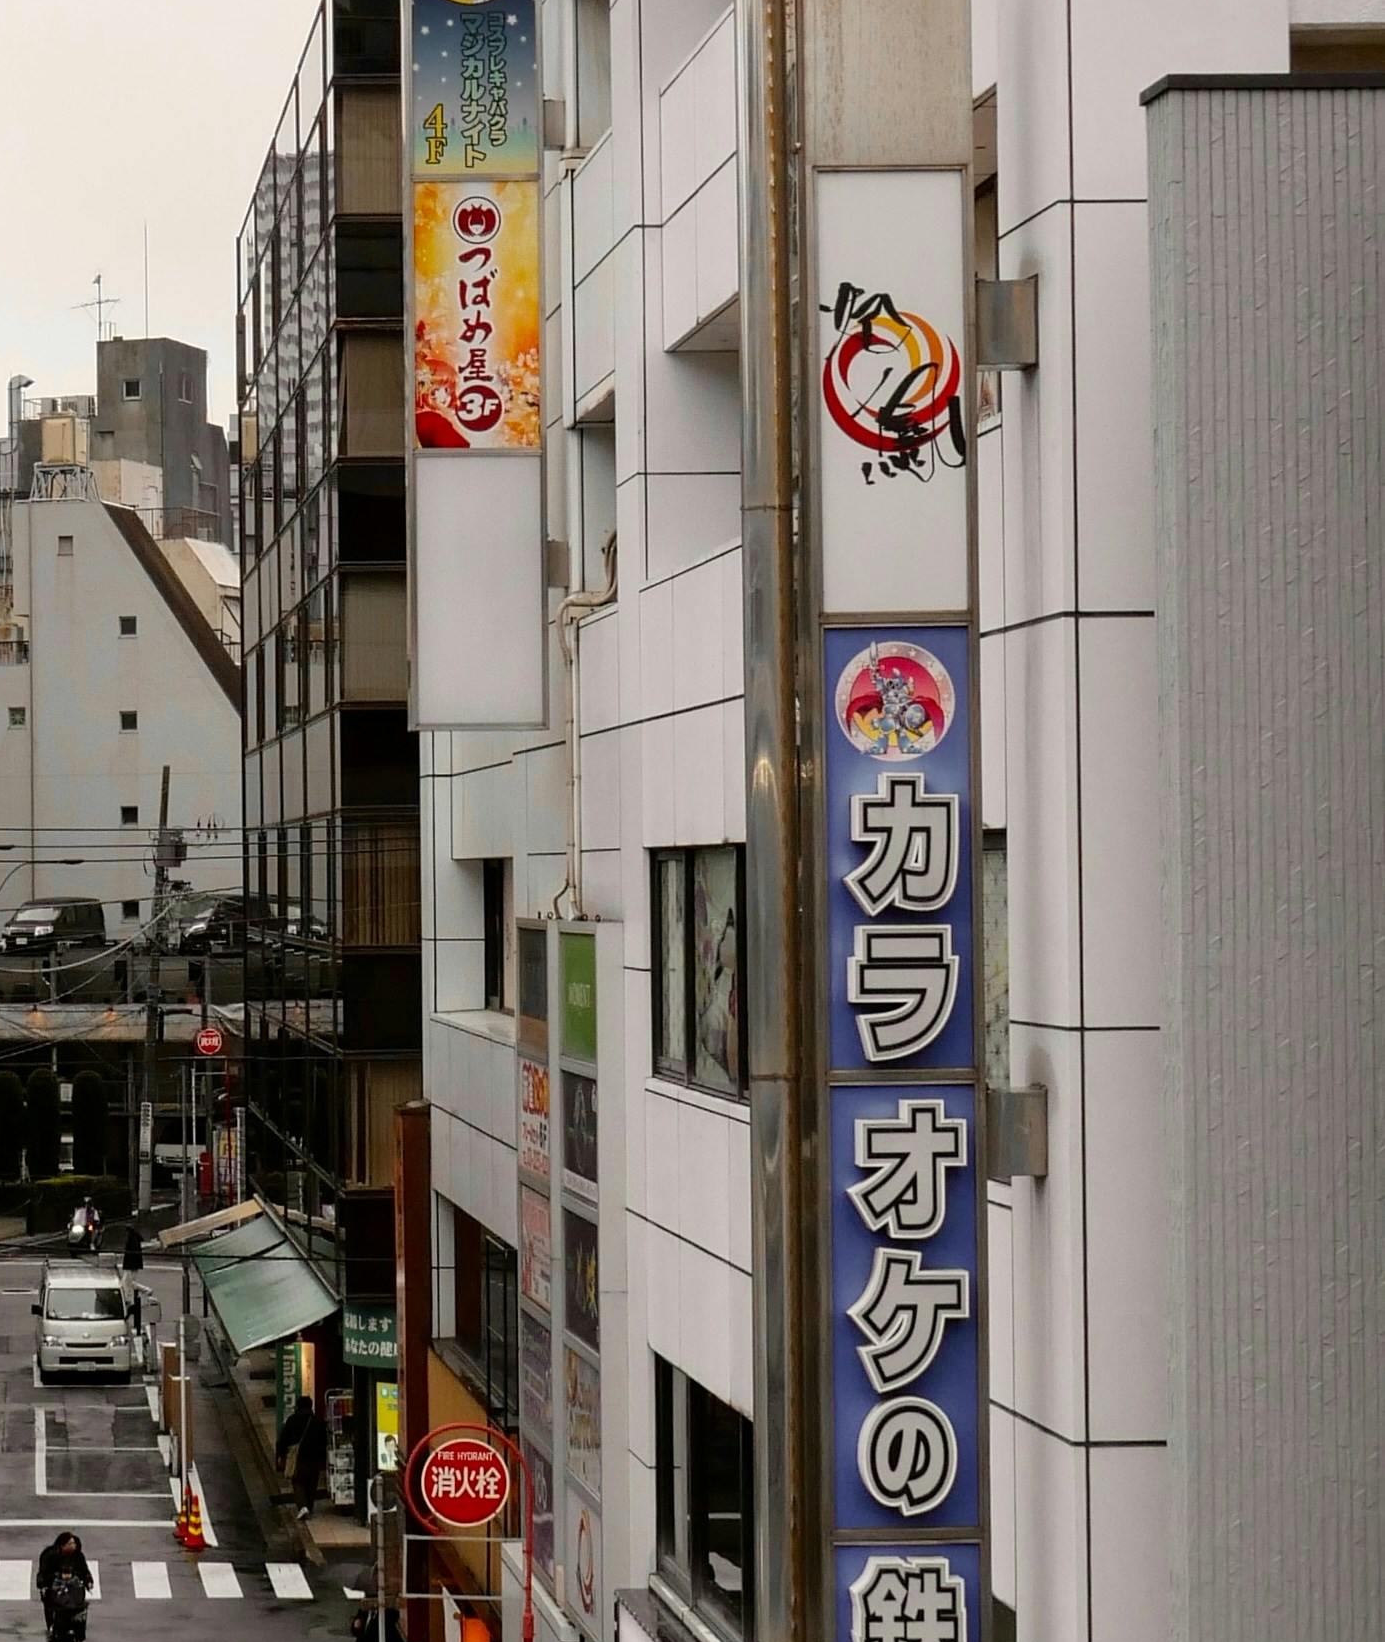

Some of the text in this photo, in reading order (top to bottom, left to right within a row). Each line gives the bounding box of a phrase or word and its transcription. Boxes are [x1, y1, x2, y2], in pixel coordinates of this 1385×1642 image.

[461, 12, 486, 168] マジカルナイト
[424, 103, 448, 164] 4F
[458, 247, 498, 382] つばめ屋
[458, 393, 499, 421] 3F
[437, 1451, 493, 1461] FIRE HYDRANT
[431, 1465, 501, 1498] 消火栓
